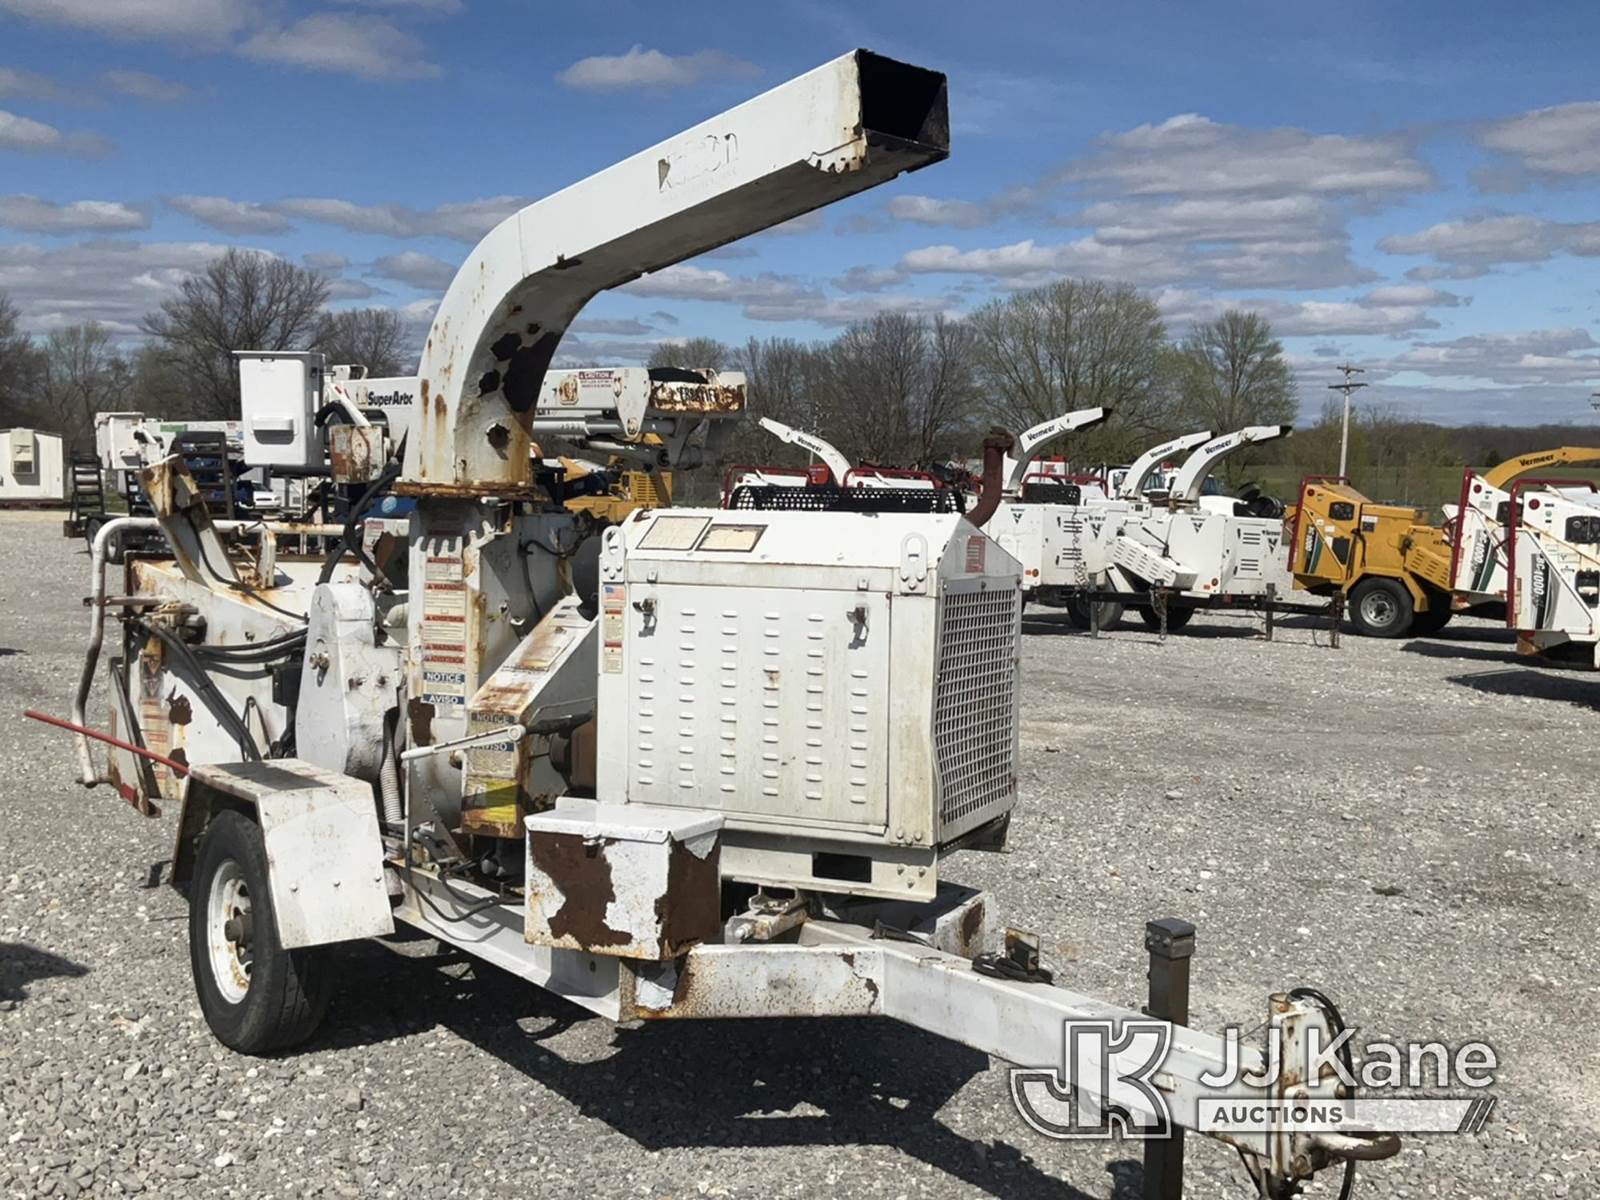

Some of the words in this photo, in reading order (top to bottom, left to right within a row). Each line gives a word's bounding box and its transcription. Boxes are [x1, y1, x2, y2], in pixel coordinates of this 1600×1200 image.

[1027, 424, 1055, 441] Vermeer
[797, 436, 822, 452] Vermeer
[1204, 439, 1232, 454] Vermeer
[1149, 445, 1173, 458] Vermeer
[1519, 454, 1554, 466] Vermeer
[426, 673, 462, 682] NOTICE
[429, 695, 458, 704] AVISO
[476, 714, 509, 723] NOTICE
